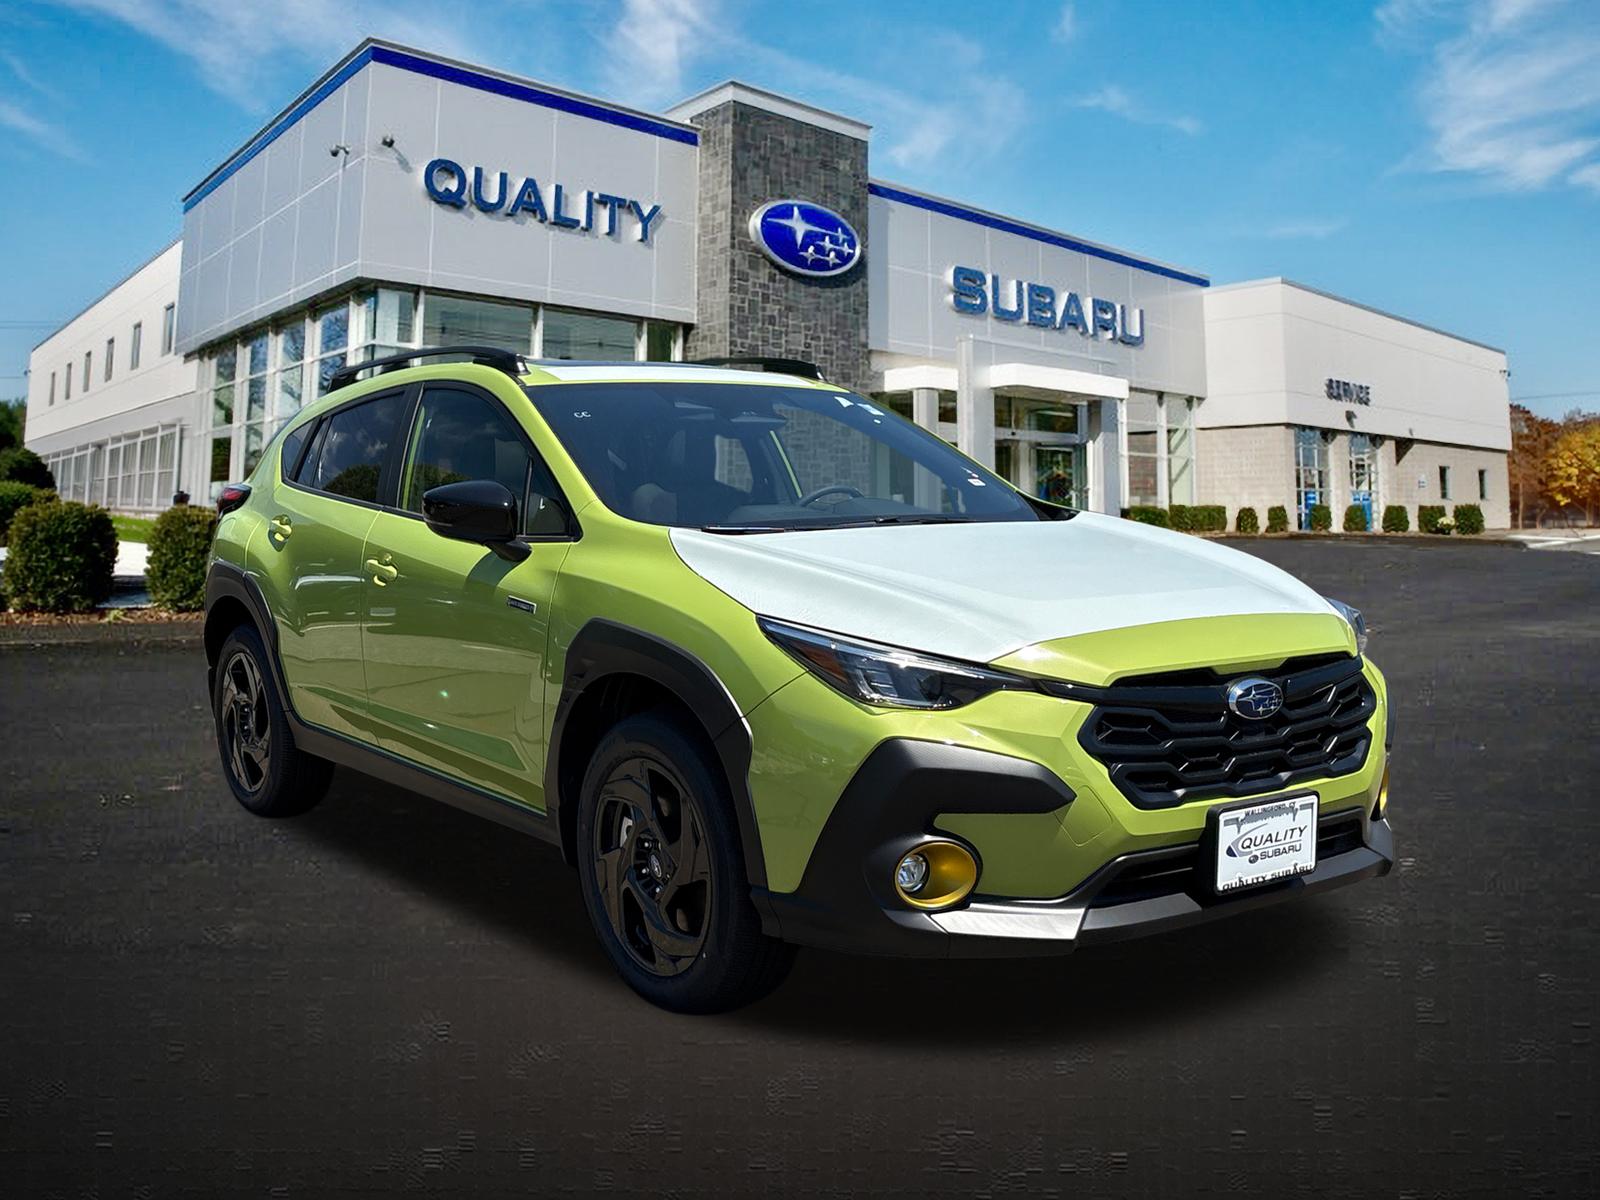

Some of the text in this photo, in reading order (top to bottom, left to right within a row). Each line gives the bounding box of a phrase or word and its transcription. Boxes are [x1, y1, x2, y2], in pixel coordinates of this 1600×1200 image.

[424, 158, 662, 242] QUALITY
[950, 264, 1145, 347] SUBARU
[1240, 825, 1308, 850] QUALITY
[1260, 843, 1302, 861] SUBARU
